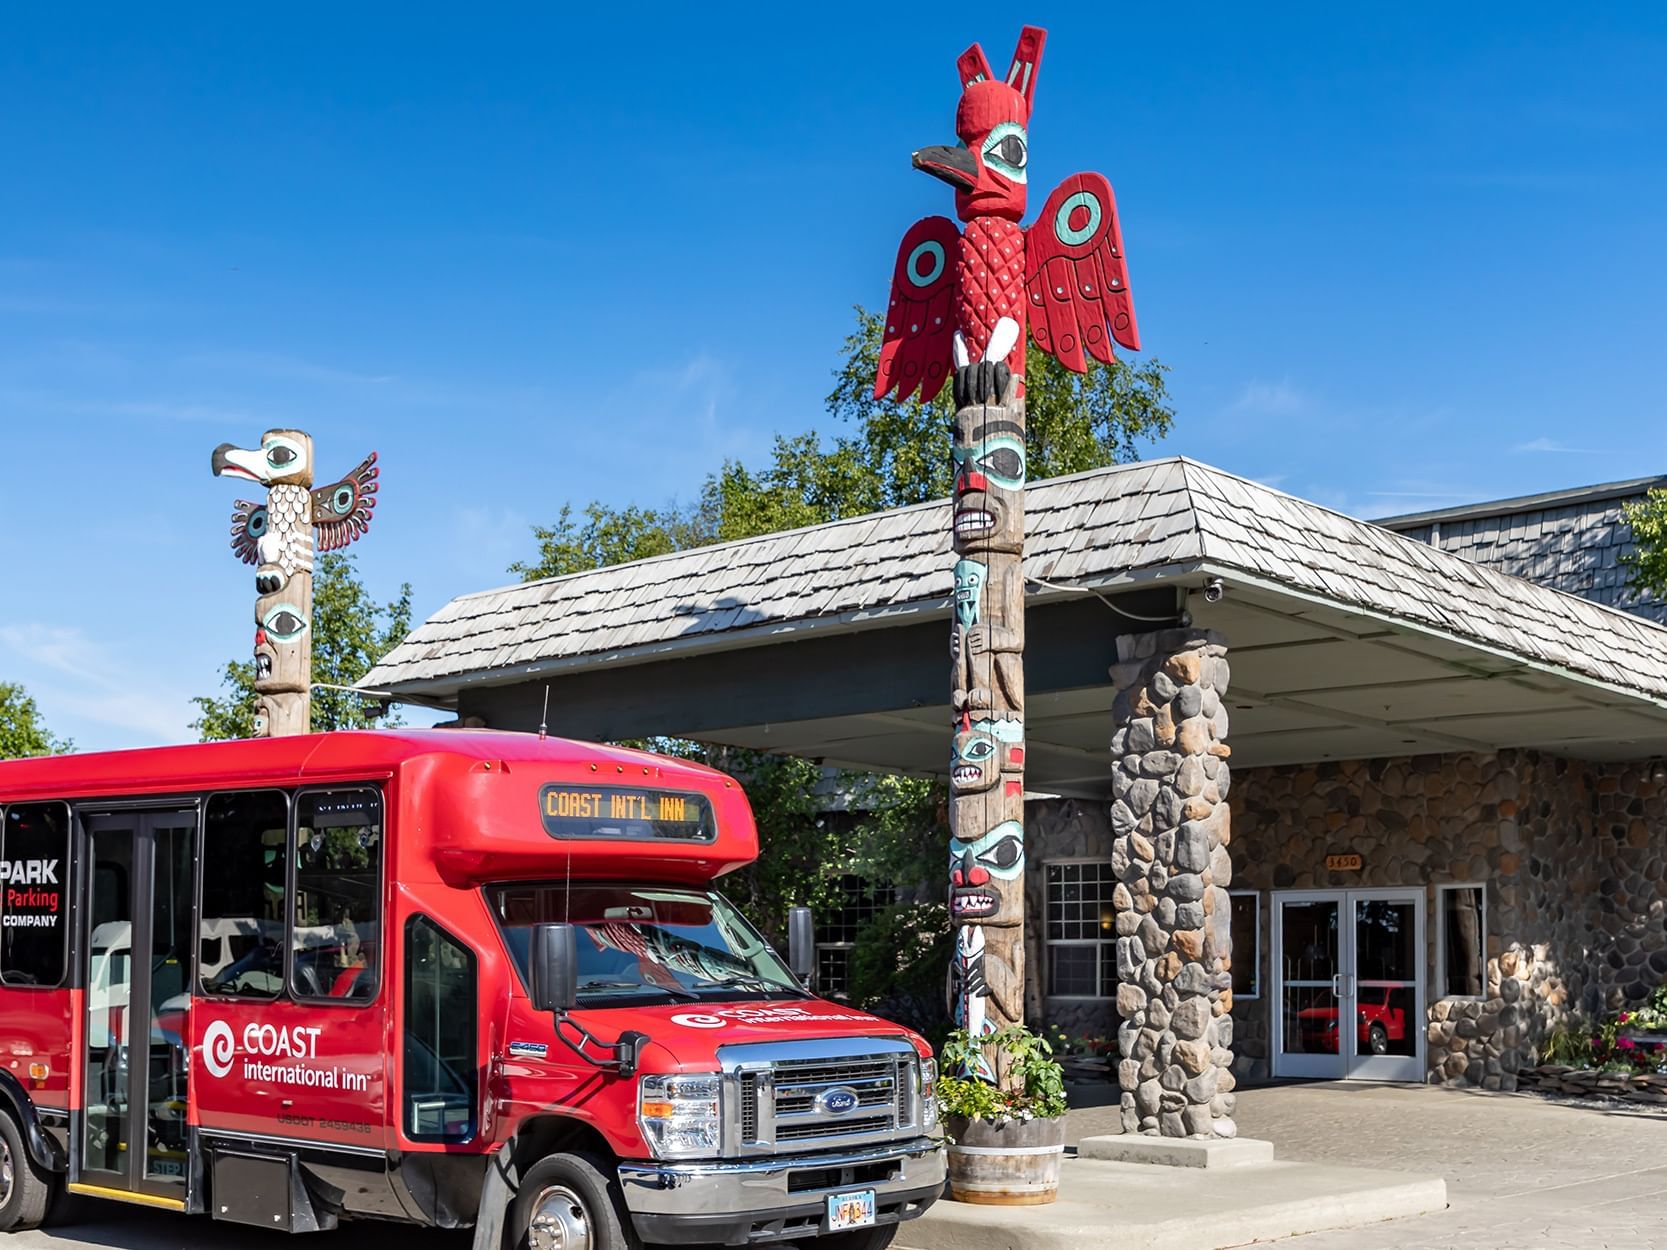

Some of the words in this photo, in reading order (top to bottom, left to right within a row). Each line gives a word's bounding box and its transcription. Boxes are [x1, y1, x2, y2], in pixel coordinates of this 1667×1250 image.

[547, 791, 602, 818] COAST
[610, 794, 651, 820] INT'L
[660, 797, 685, 821] INN
[0, 859, 59, 884] PARK
[1329, 857, 1357, 868] 3450
[7, 887, 58, 912] Parking
[3, 914, 58, 927] COMPANY
[718, 1007, 812, 1018] COAST
[243, 1022, 321, 1059] COAST
[243, 1058, 338, 1089] international
[831, 1095, 851, 1108] Ford
[277, 1113, 316, 1127] USDOT
